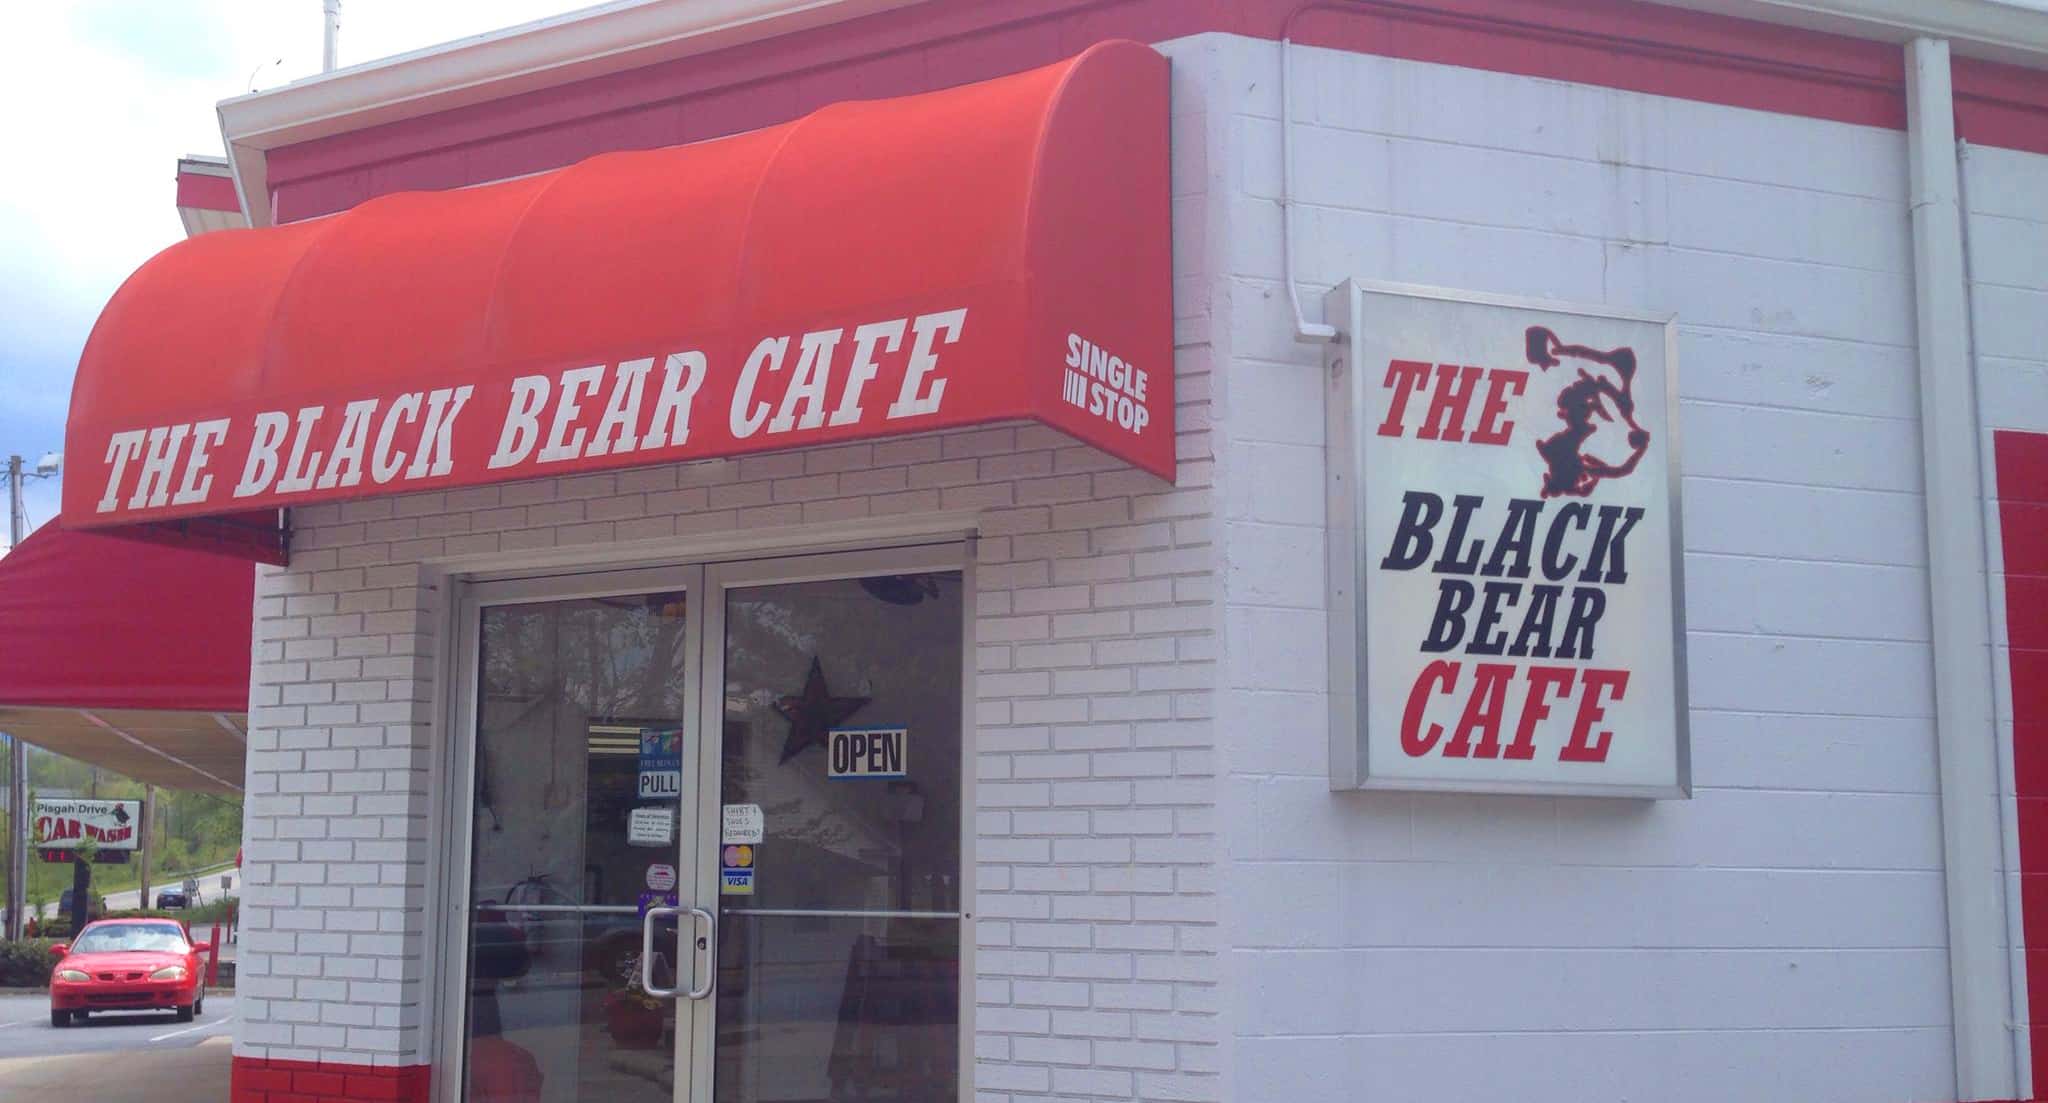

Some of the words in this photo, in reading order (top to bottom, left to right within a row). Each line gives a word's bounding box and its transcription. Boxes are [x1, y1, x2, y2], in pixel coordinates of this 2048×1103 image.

[1065, 332, 1148, 403] SINGLE
[96, 418, 231, 513] THE
[233, 385, 475, 498] BLACK
[487, 350, 707, 470] BEAR
[729, 308, 968, 439] CAFE
[1089, 382, 1149, 434] STOP
[1377, 359, 1529, 447] THE
[1379, 490, 1645, 584] BLACK
[1420, 578, 1607, 660] BEAR
[1400, 659, 1630, 763] CAFE
[641, 775, 678, 793] PULL
[832, 733, 902, 774] OPEN
[36, 816, 82, 843] CAR
[85, 823, 132, 843] WASH
[37, 803, 75, 815] Pisgah
[78, 803, 108, 815] Drive
[727, 876, 749, 887] VISA
